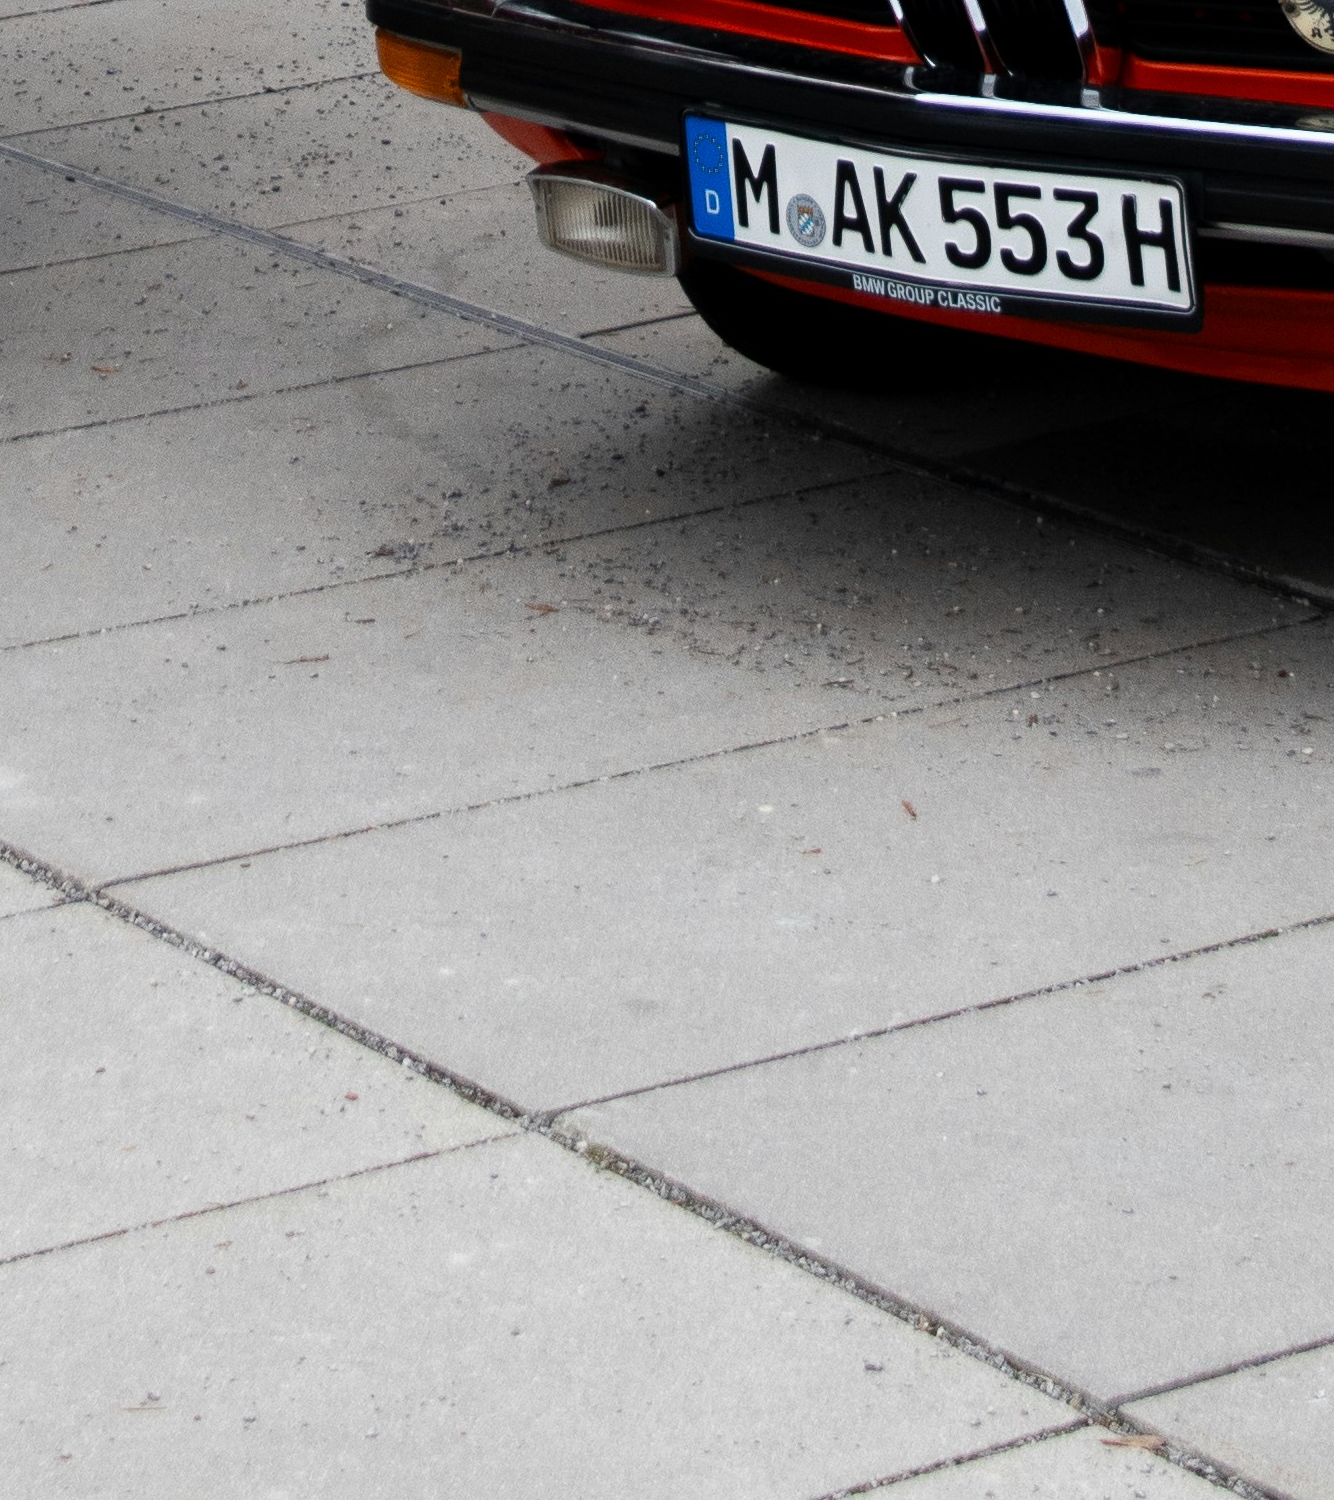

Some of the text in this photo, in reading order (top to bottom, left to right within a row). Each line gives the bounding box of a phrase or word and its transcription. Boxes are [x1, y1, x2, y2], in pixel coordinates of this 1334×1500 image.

[704, 188, 721, 216] D
[831, 158, 927, 264] AK
[852, 273, 1002, 313] BMW GROUP CLASSIC
